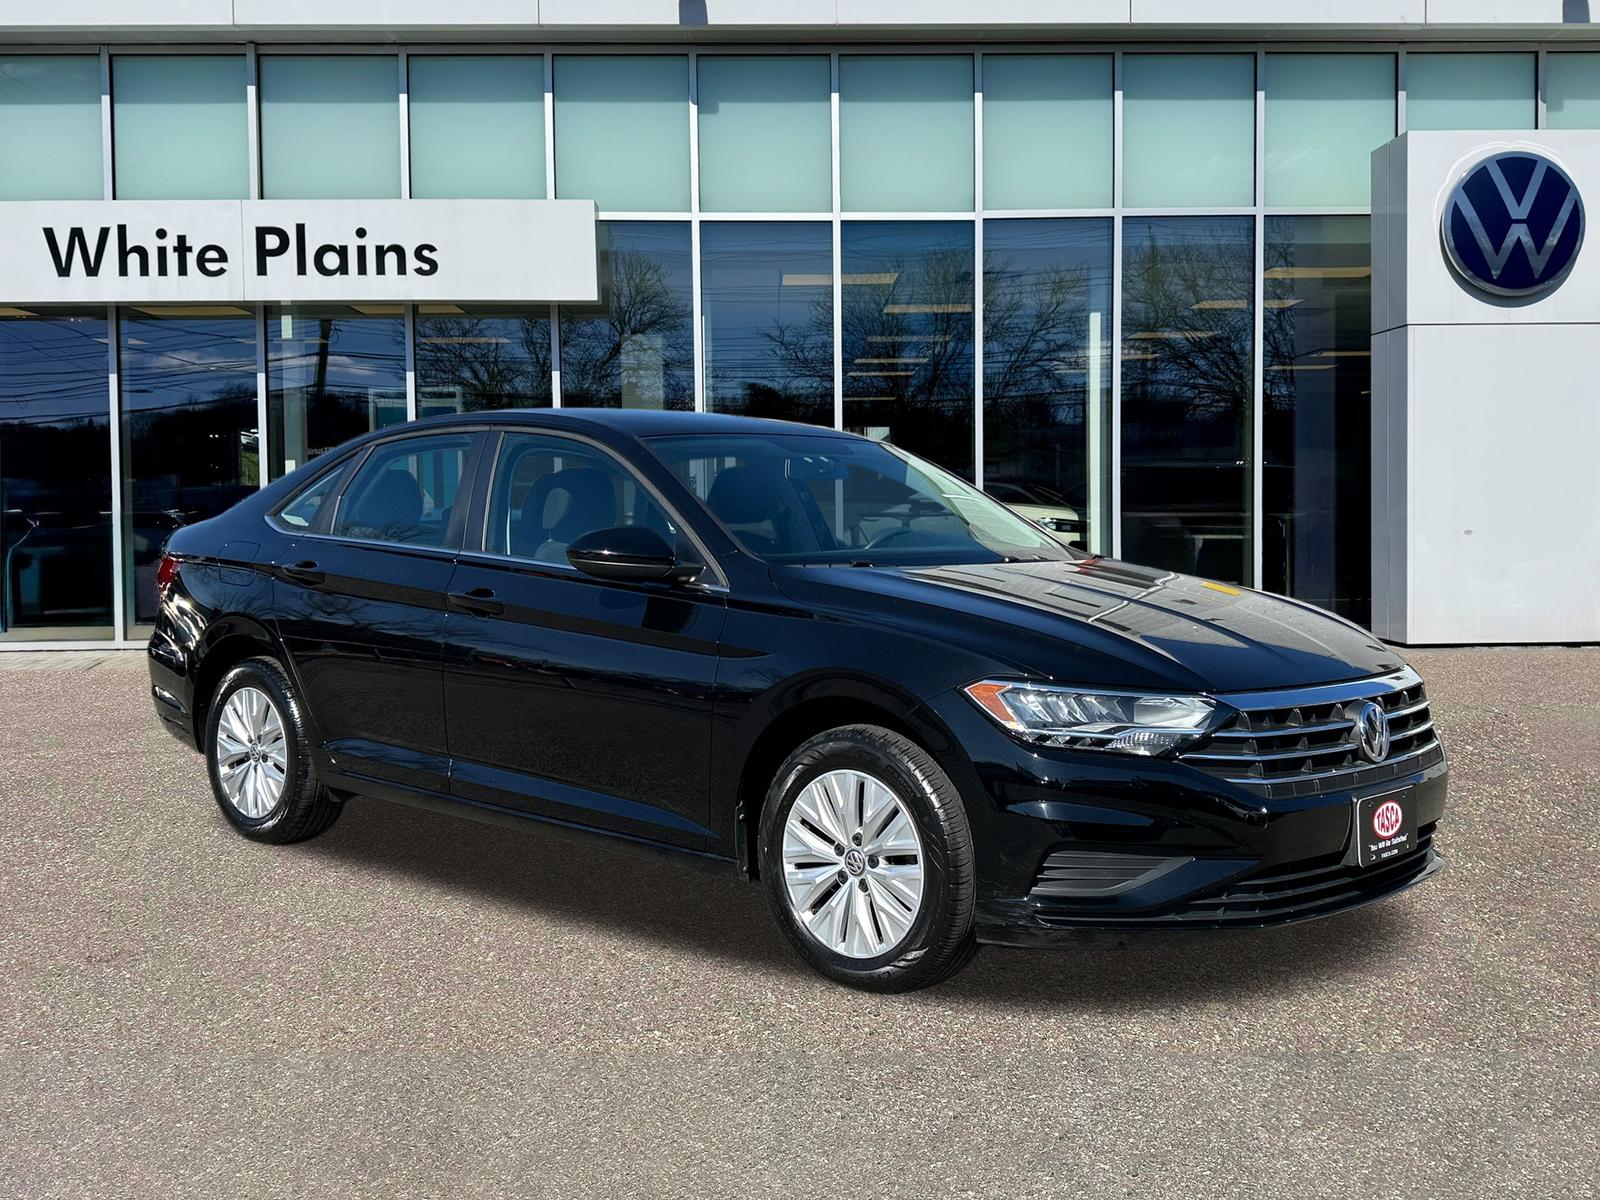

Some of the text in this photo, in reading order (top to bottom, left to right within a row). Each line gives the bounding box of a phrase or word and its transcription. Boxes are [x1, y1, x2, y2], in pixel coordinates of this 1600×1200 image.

[42, 223, 440, 278] White Plains
[1377, 806, 1399, 833] TASCA
